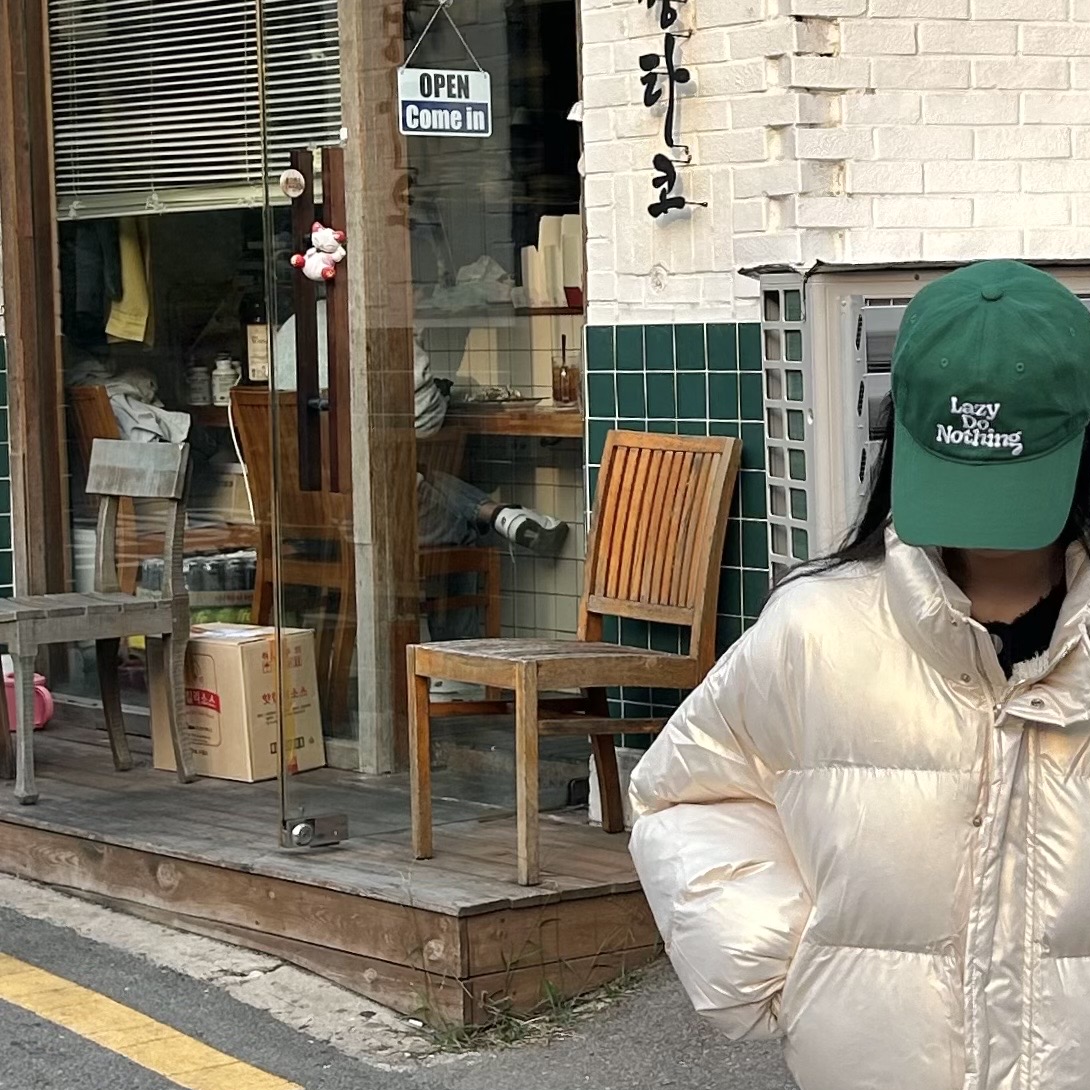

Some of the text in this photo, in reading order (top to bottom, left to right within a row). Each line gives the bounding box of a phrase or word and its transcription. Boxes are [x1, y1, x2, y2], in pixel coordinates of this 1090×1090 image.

[419, 72, 470, 99] OPEN
[405, 104, 486, 131] Come in
[951, 396, 1000, 420] Lazy
[961, 414, 990, 430] Do
[936, 424, 1023, 456] Nothing
